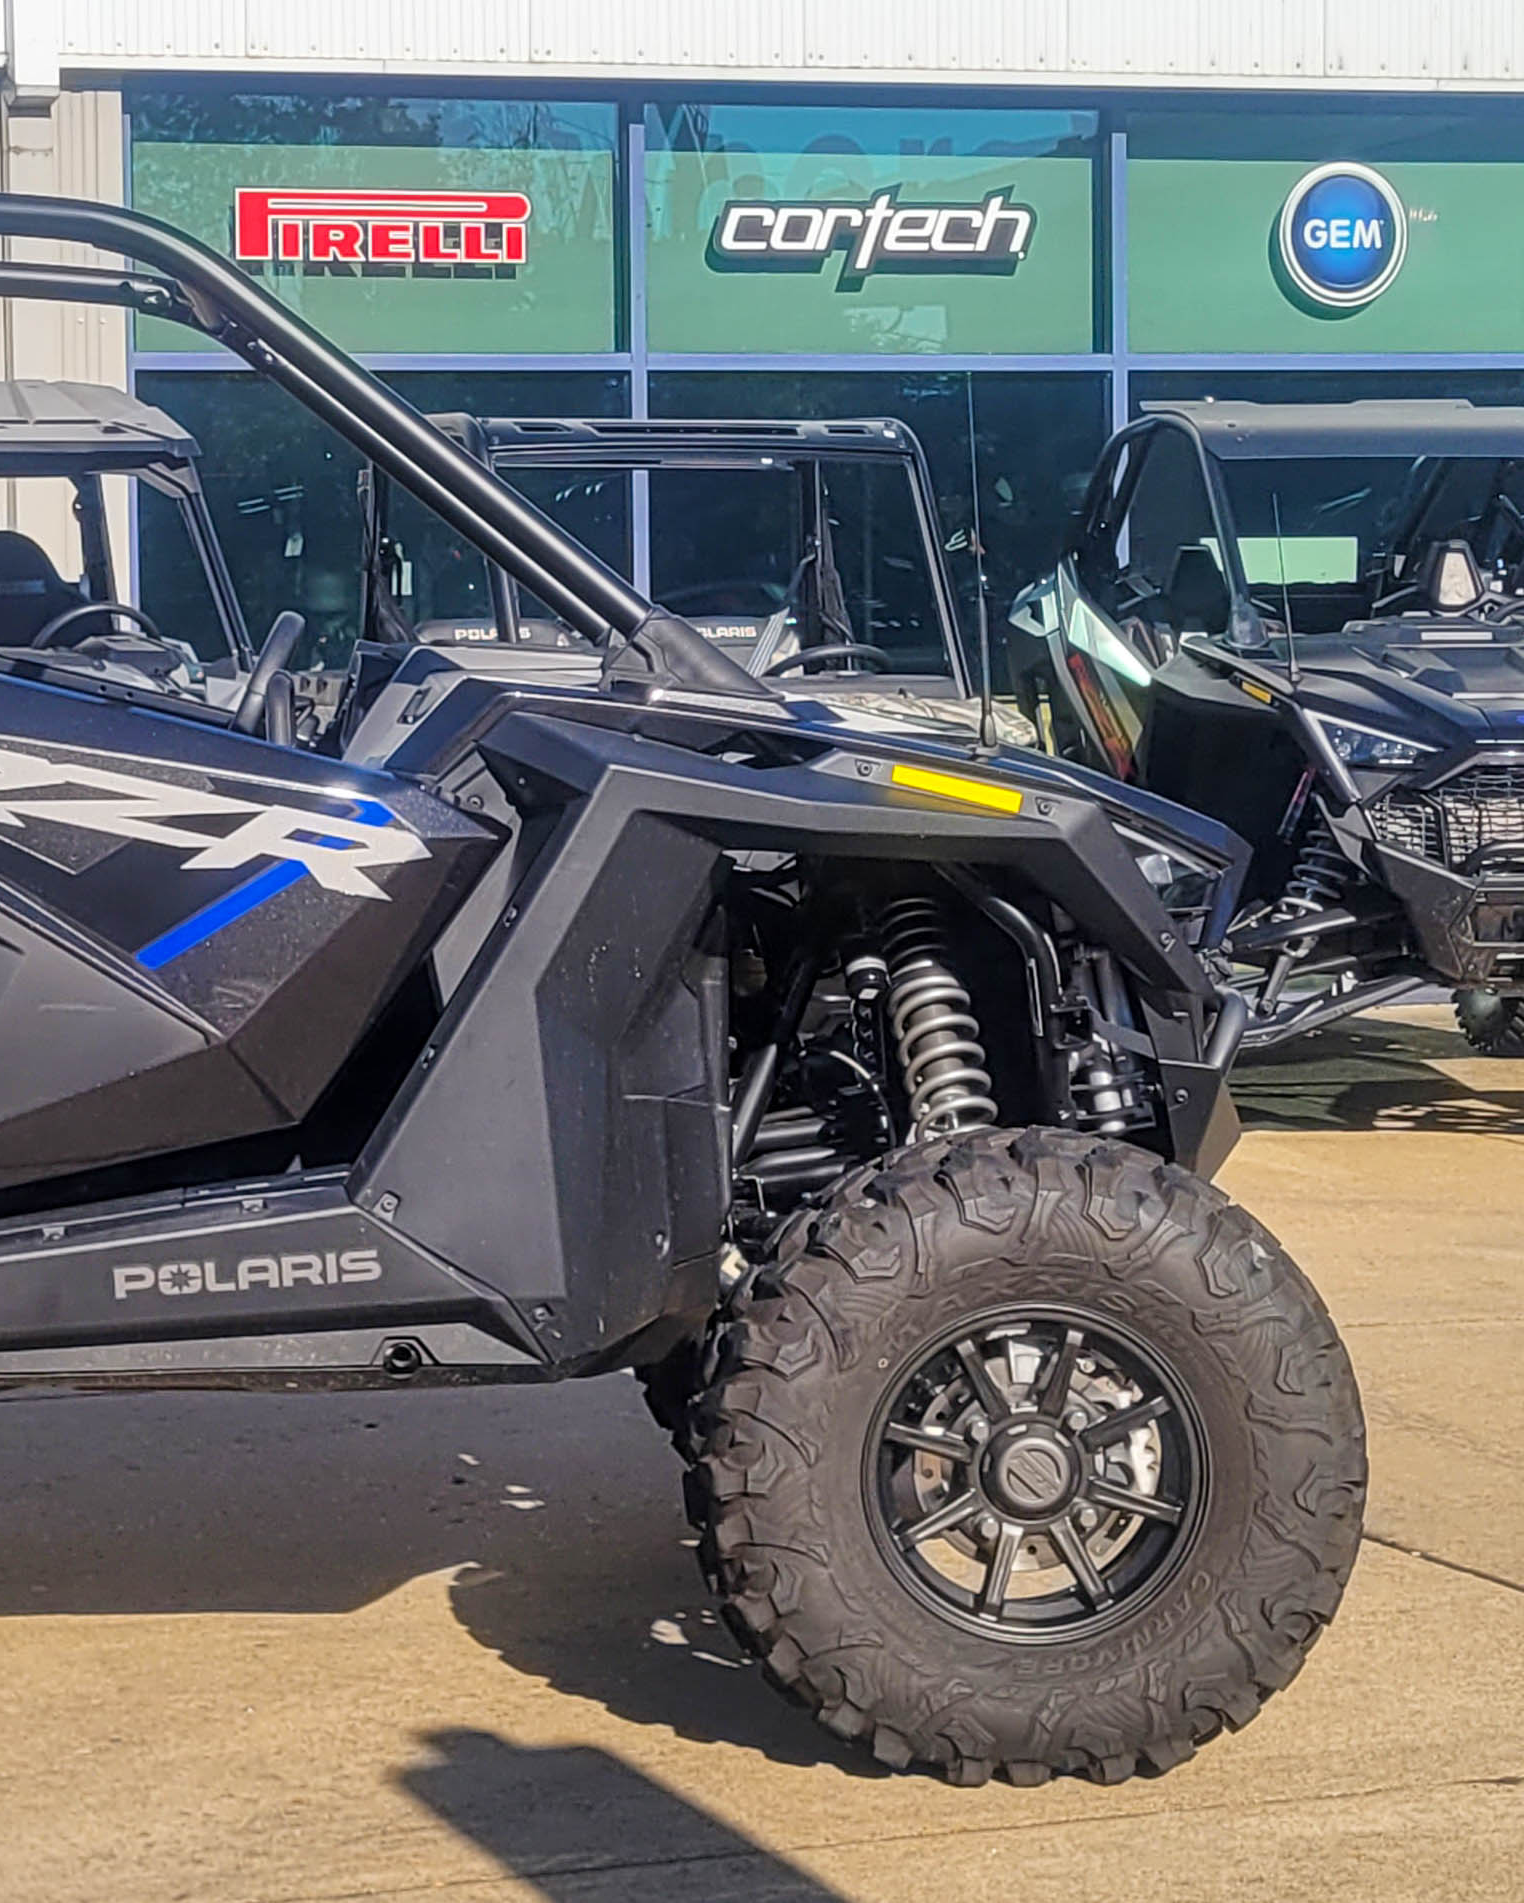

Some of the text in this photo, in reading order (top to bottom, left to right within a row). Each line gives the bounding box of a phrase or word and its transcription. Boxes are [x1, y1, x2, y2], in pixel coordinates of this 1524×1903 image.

[234, 187, 532, 265] PIRELLI
[720, 193, 1031, 270] cortech
[1303, 218, 1384, 250] GEM
[696, 625, 757, 638] OLARIS
[112, 1248, 383, 1301] POLARIS
